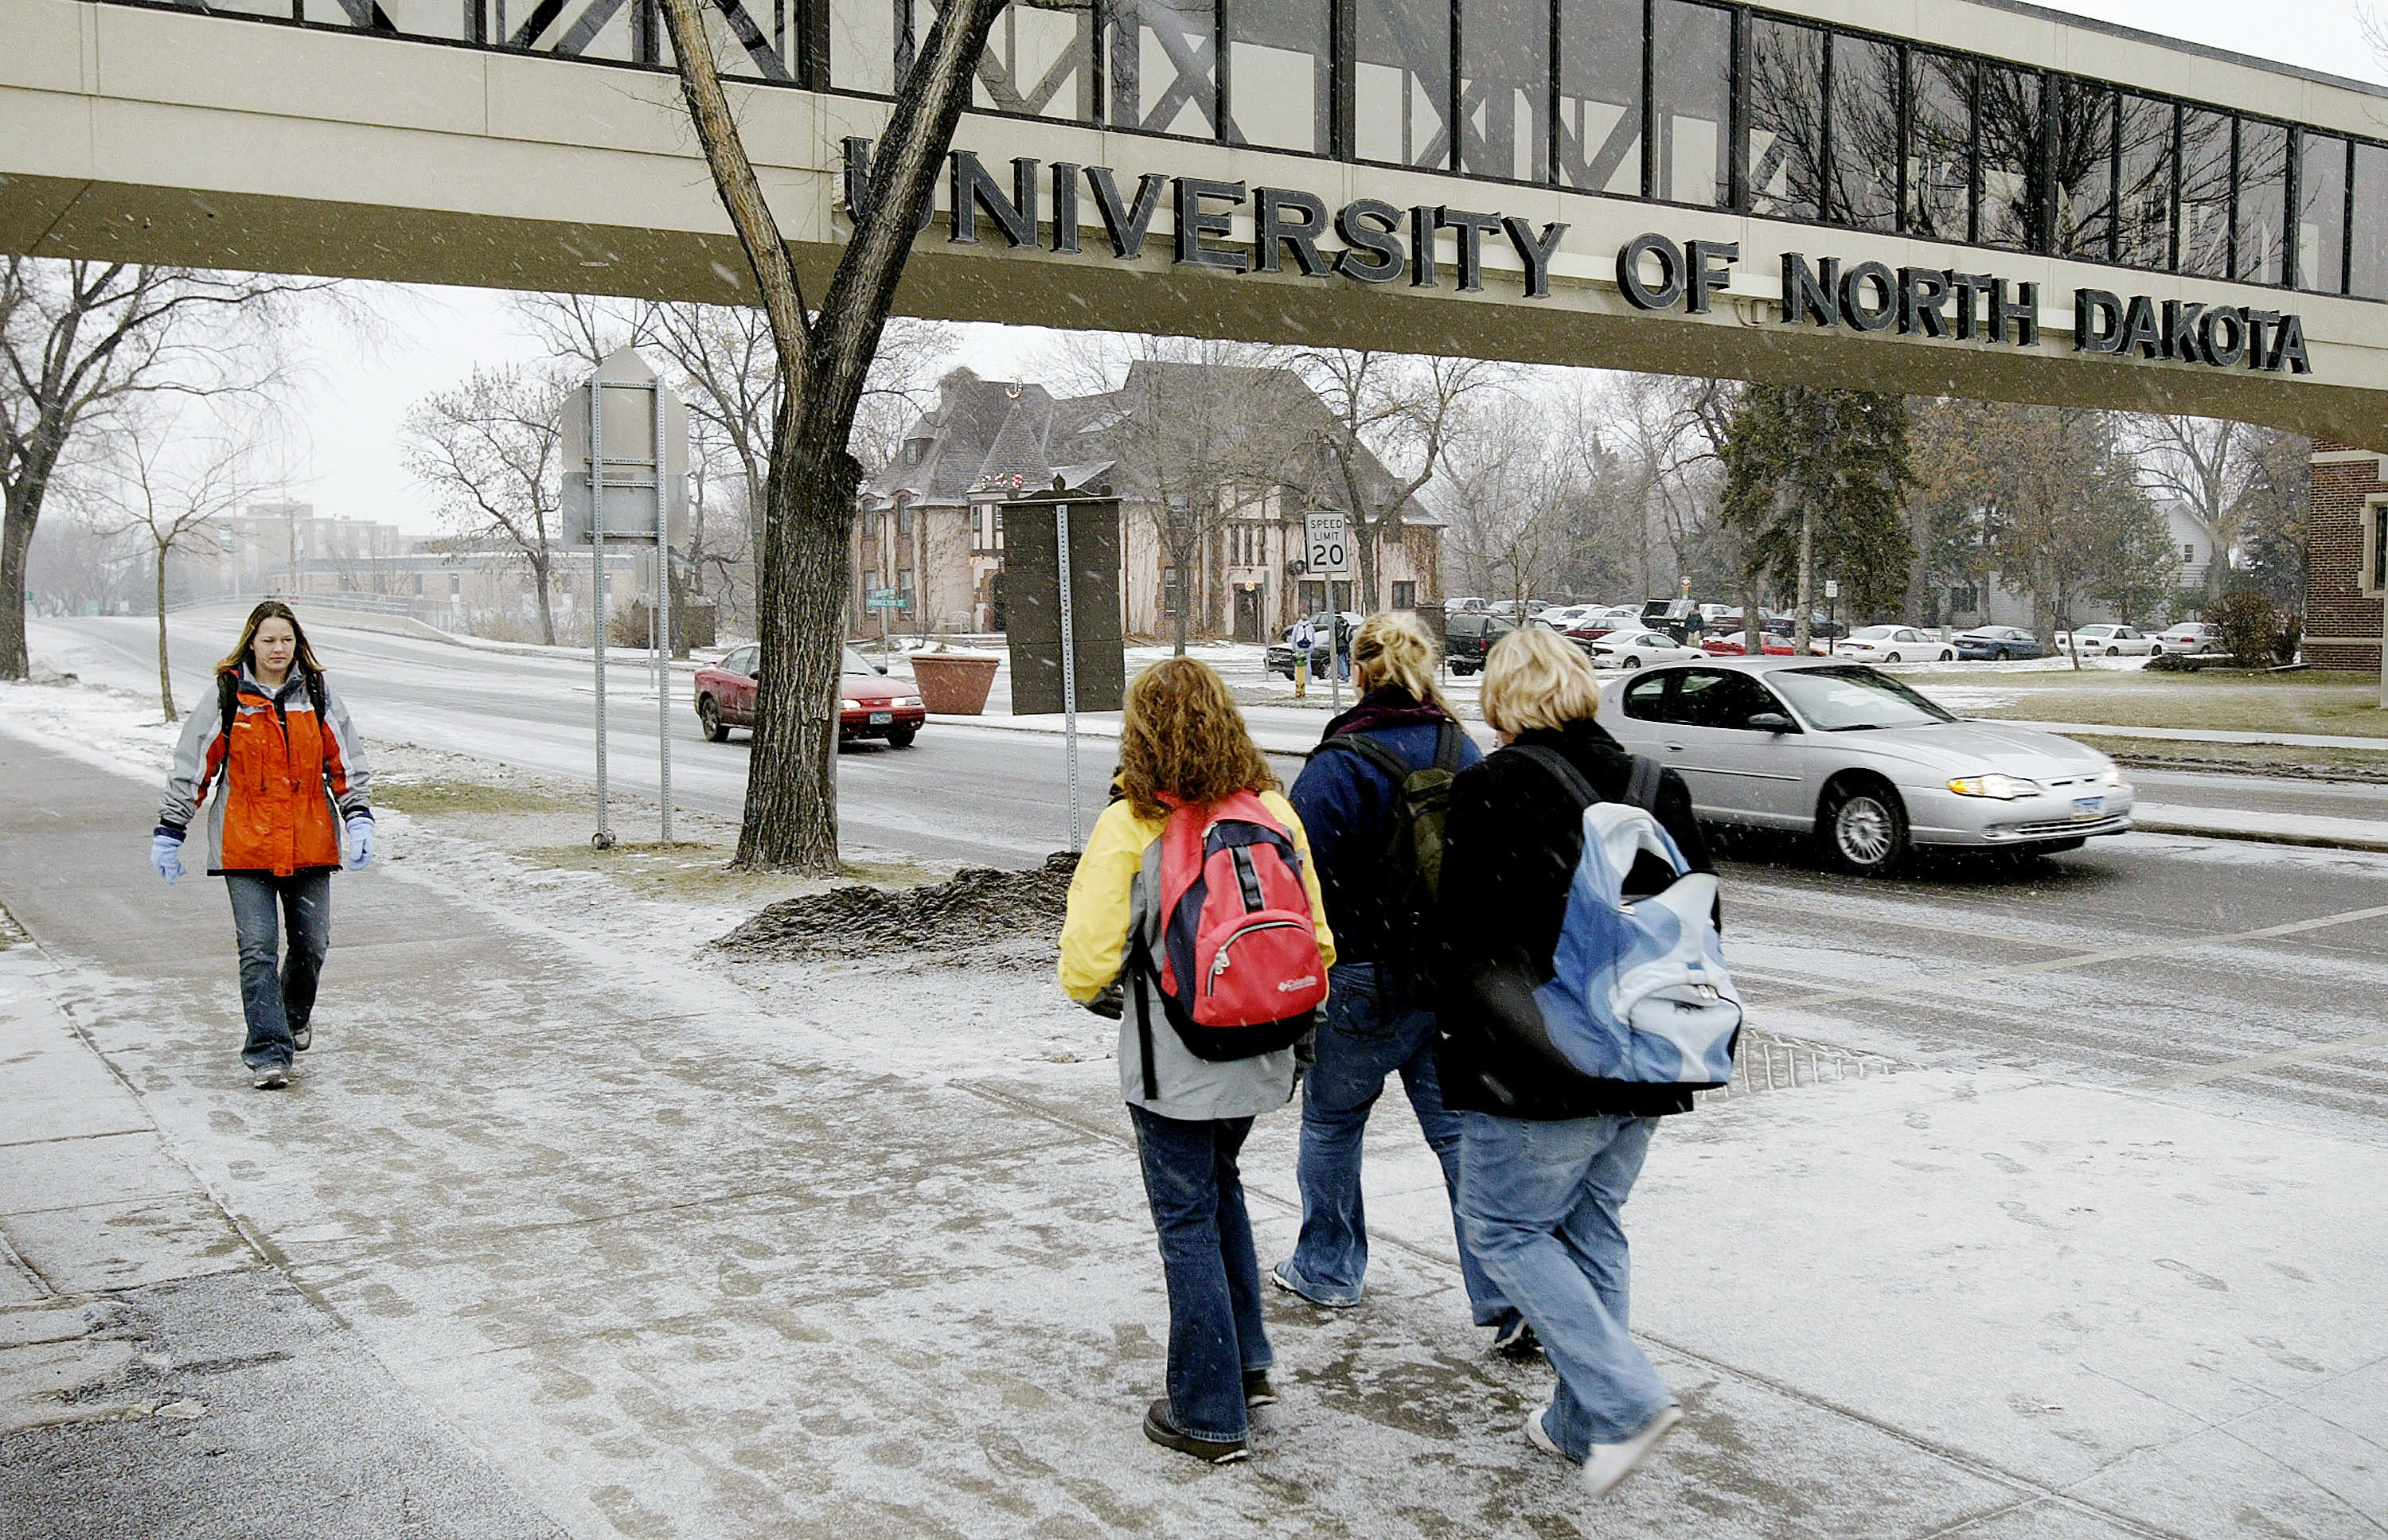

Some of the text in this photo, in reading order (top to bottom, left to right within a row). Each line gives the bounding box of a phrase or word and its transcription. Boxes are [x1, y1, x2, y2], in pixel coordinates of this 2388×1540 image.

[1615, 232, 1739, 314] OF
[1780, 251, 2039, 347] NORTH
[2074, 287, 2312, 374] DAKOTA
[1310, 519, 1343, 529] SPEED
[1314, 532, 1340, 541] LIMIT
[1313, 544, 1344, 566] 20
